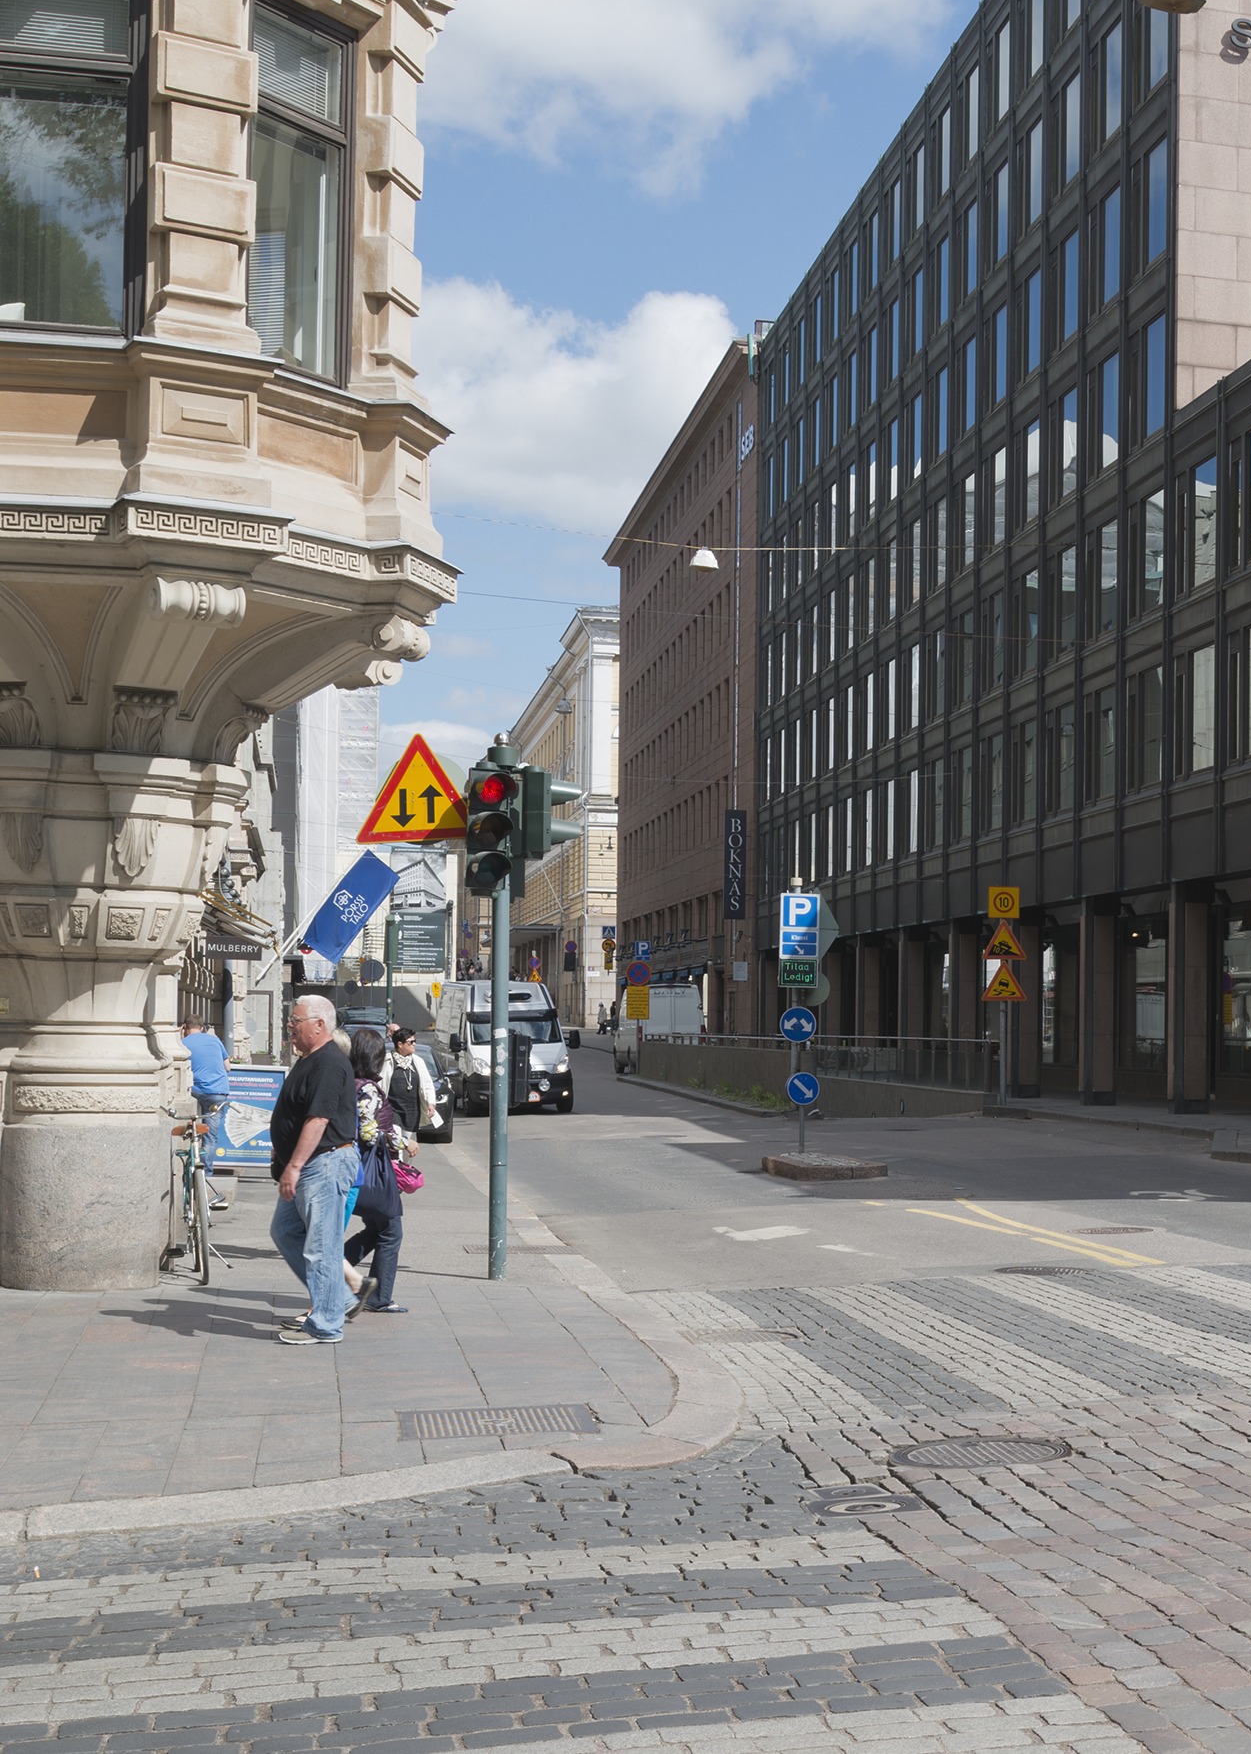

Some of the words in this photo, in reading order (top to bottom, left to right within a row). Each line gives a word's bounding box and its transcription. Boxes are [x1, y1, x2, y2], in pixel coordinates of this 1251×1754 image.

[728, 817, 742, 912] BOKNÄS
[340, 894, 366, 923] PÖRSSI
[998, 896, 1010, 908] 10
[349, 903, 369, 925] TALO
[788, 897, 812, 926] P
[207, 943, 259, 953] MULBERRY
[784, 962, 810, 971] Tilaa
[783, 972, 813, 983] Ledigt
